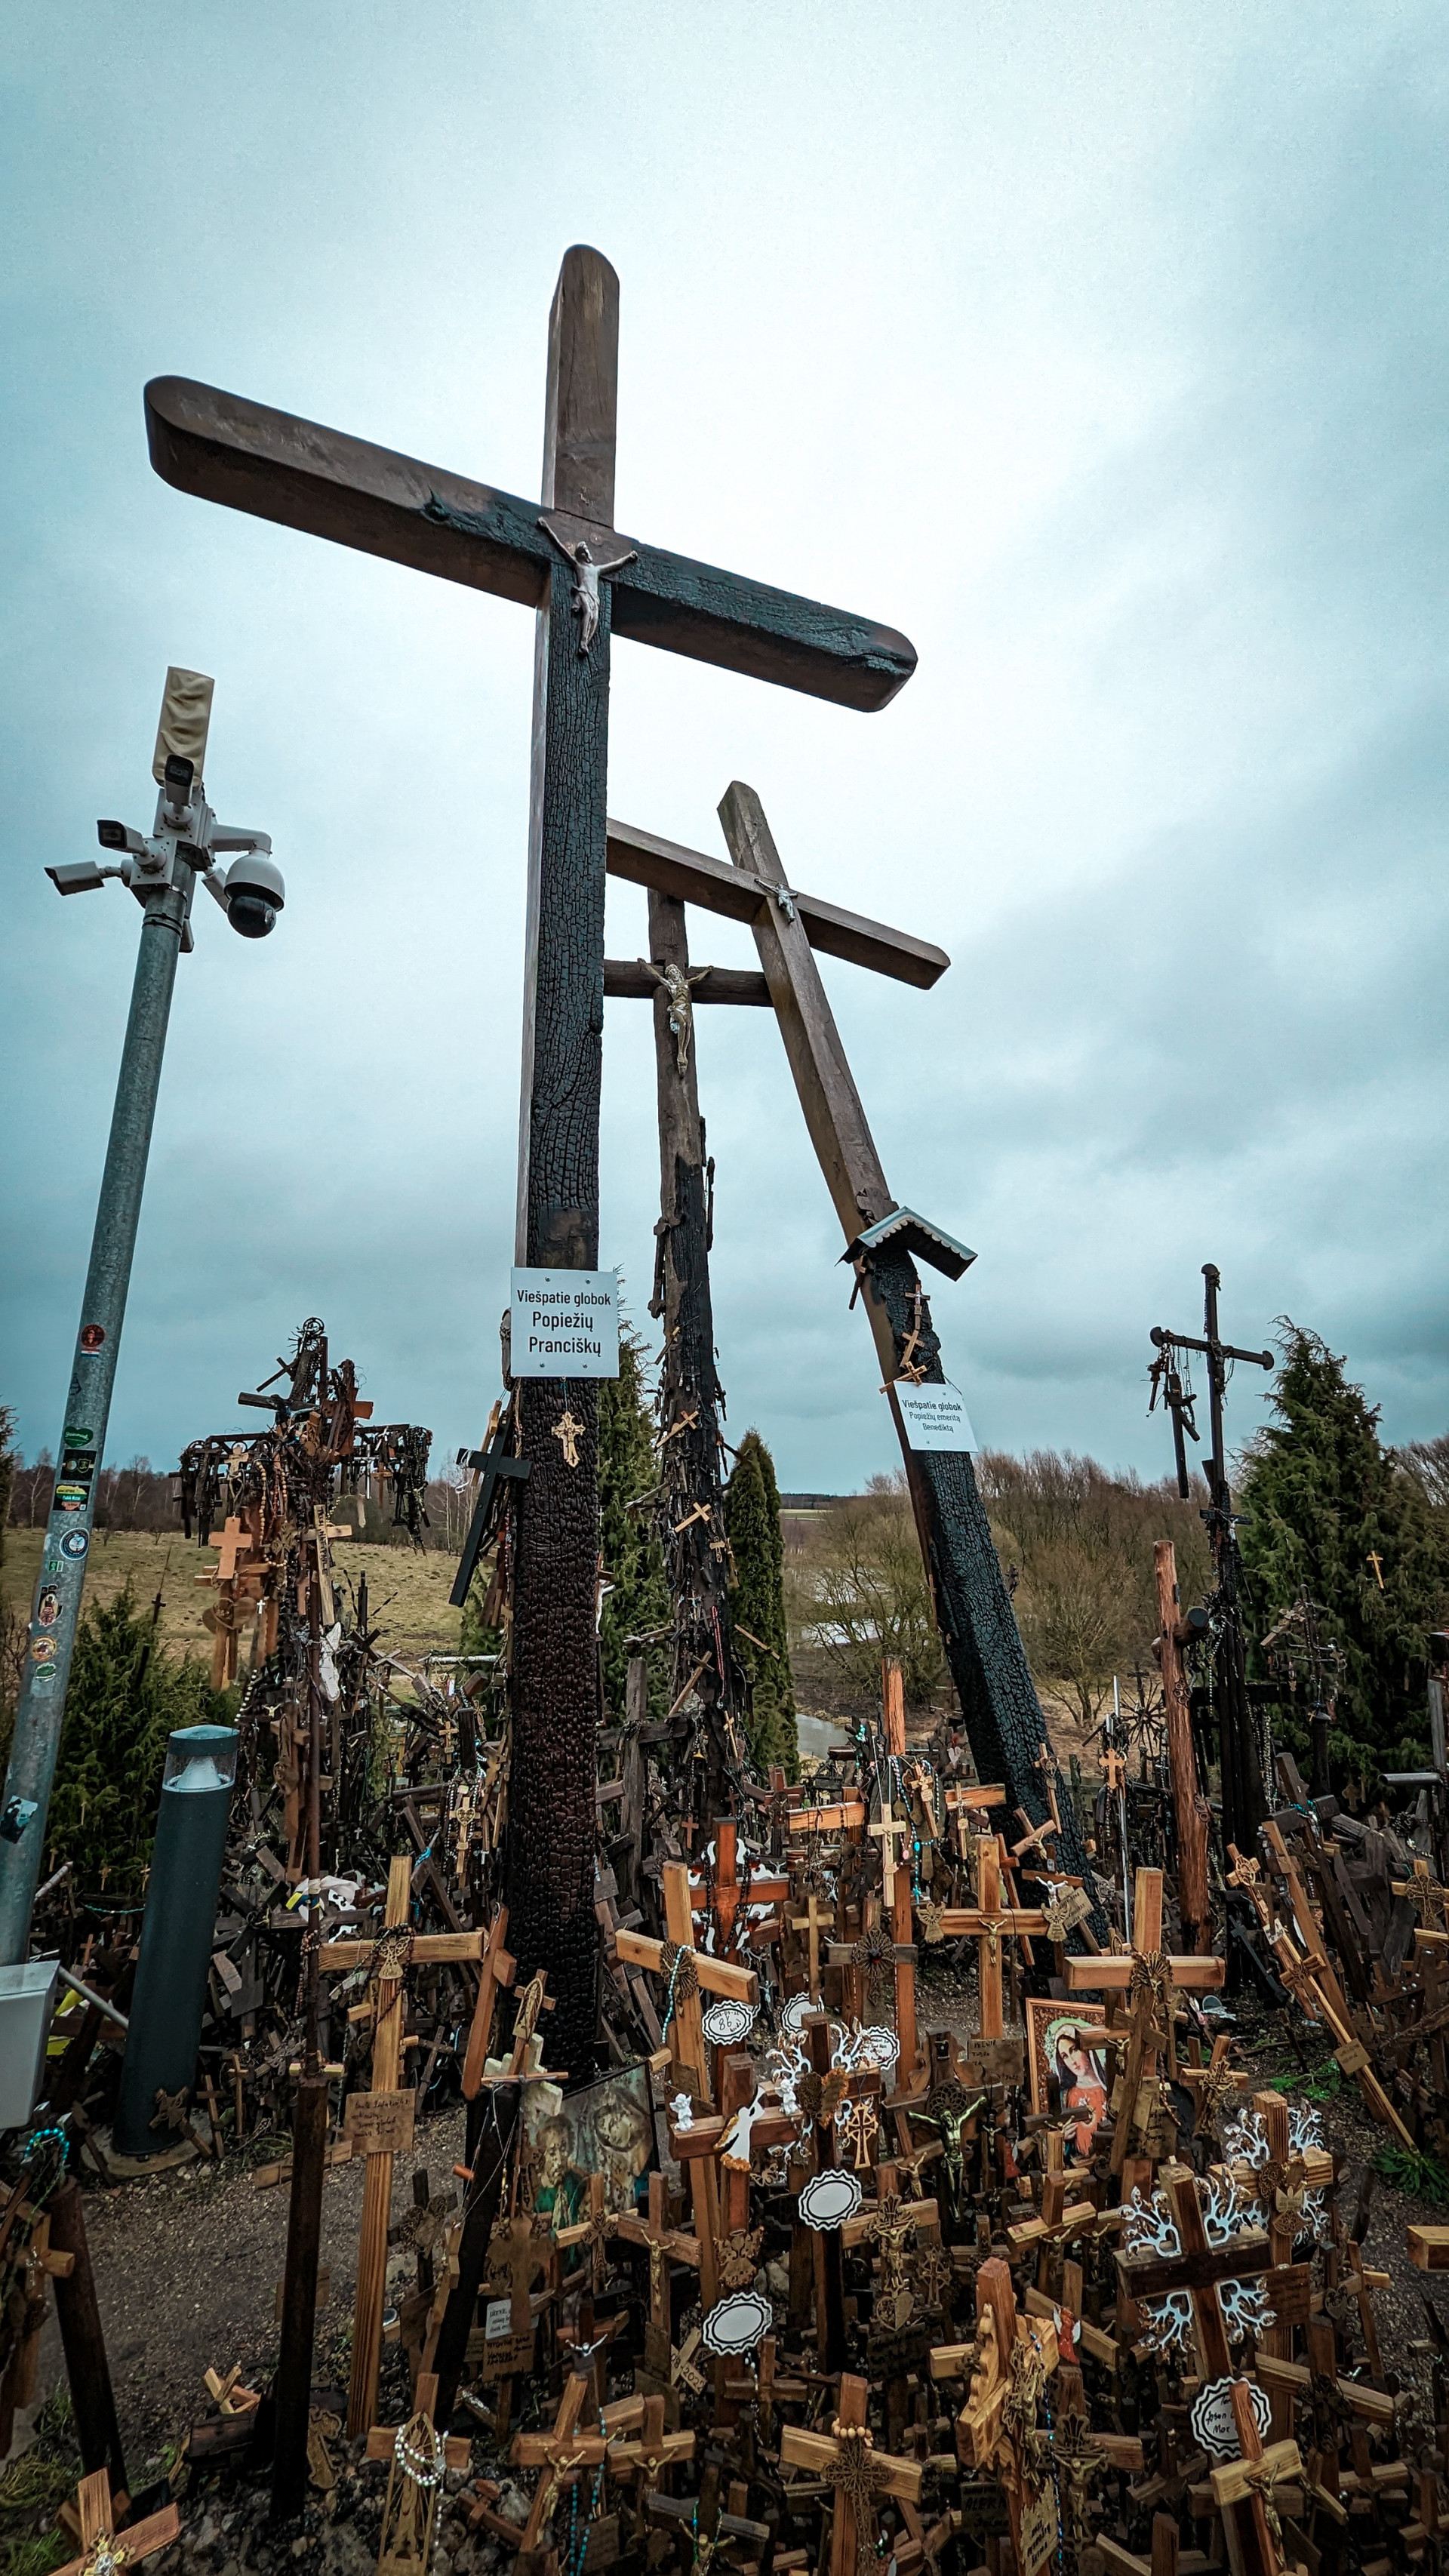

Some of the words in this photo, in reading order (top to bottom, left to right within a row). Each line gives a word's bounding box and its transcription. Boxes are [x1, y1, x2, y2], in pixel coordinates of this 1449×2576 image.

[517, 1290, 571, 1306] Viešpatie
[574, 1292, 611, 1307] globok
[533, 1311, 601, 1332] Popiežių
[529, 1336, 601, 1357] Pranciškų
[902, 1399, 937, 1410] Viešpatie
[938, 1403, 962, 1412] globok
[909, 1411, 936, 1422] Popiežių
